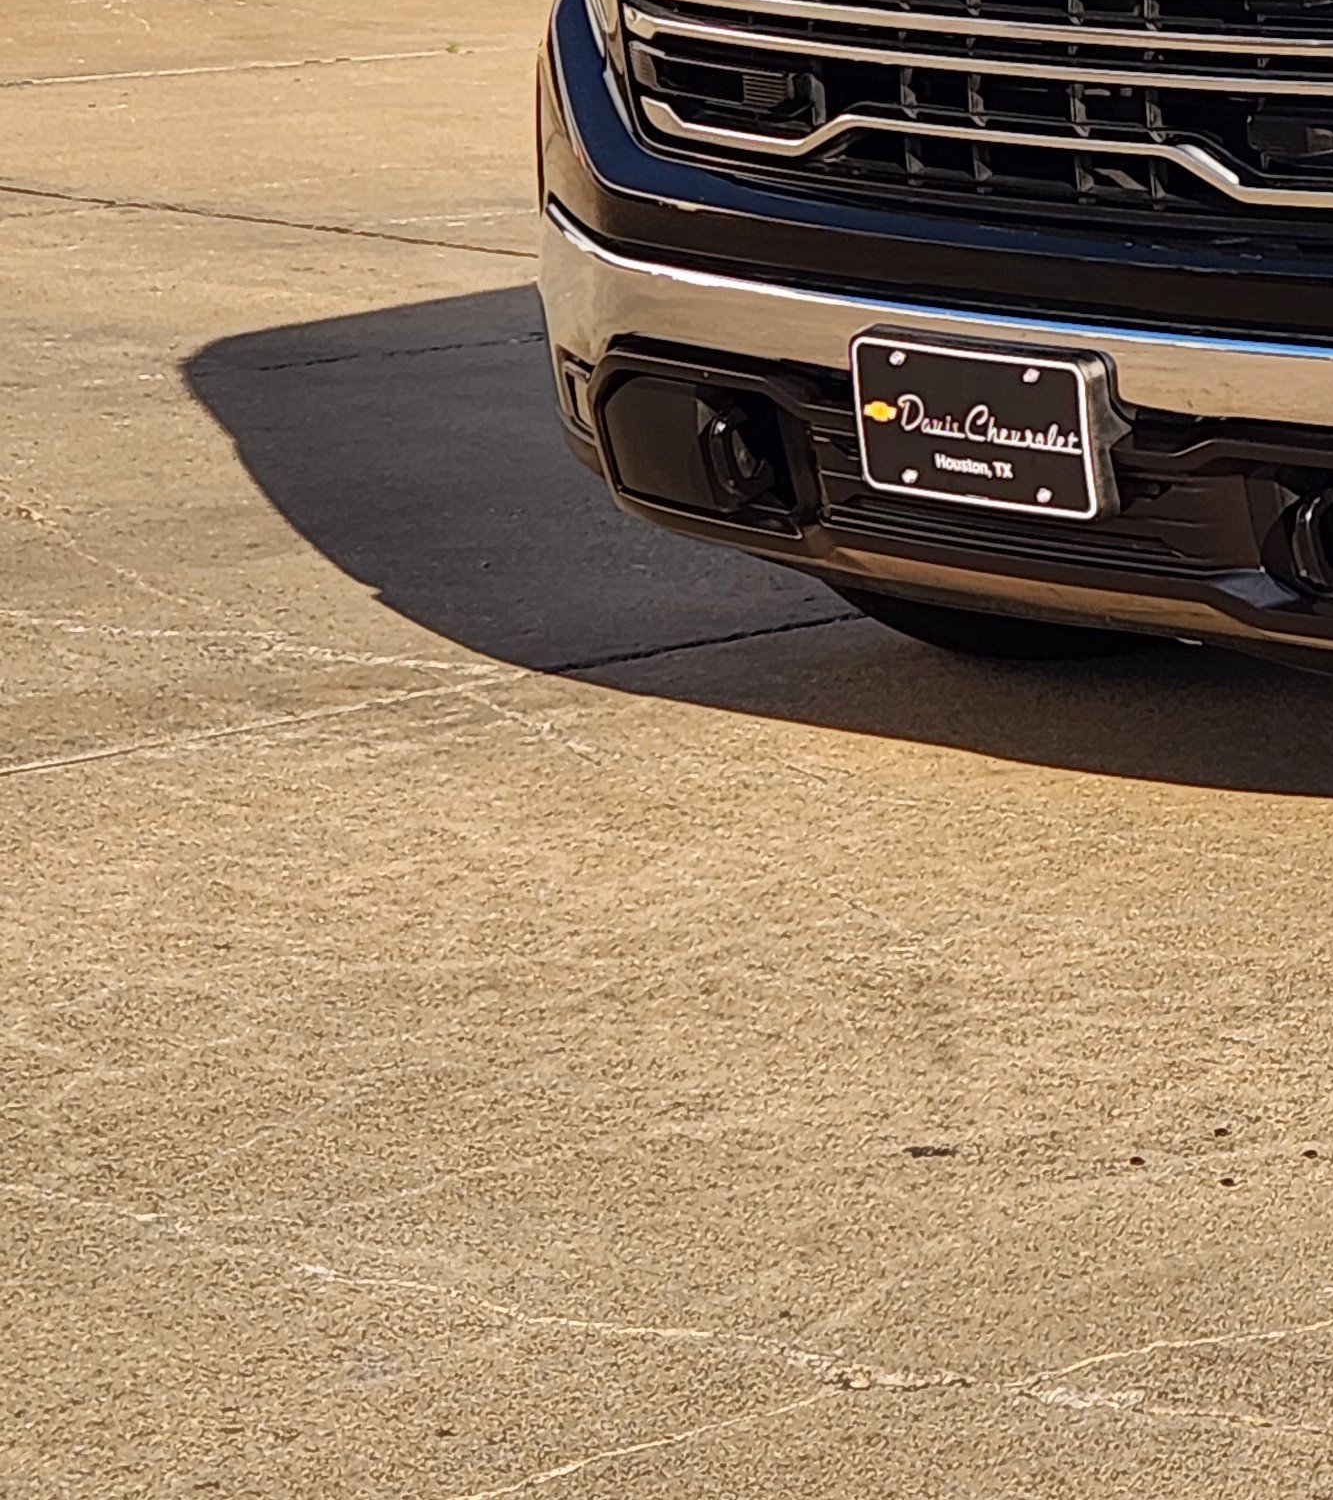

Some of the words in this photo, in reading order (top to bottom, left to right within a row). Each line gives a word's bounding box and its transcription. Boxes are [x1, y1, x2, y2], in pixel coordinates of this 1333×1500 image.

[897, 393, 965, 439] Davis
[964, 404, 1082, 455] Chevrolet
[934, 452, 993, 478] Houston,
[993, 460, 1014, 479] TX
